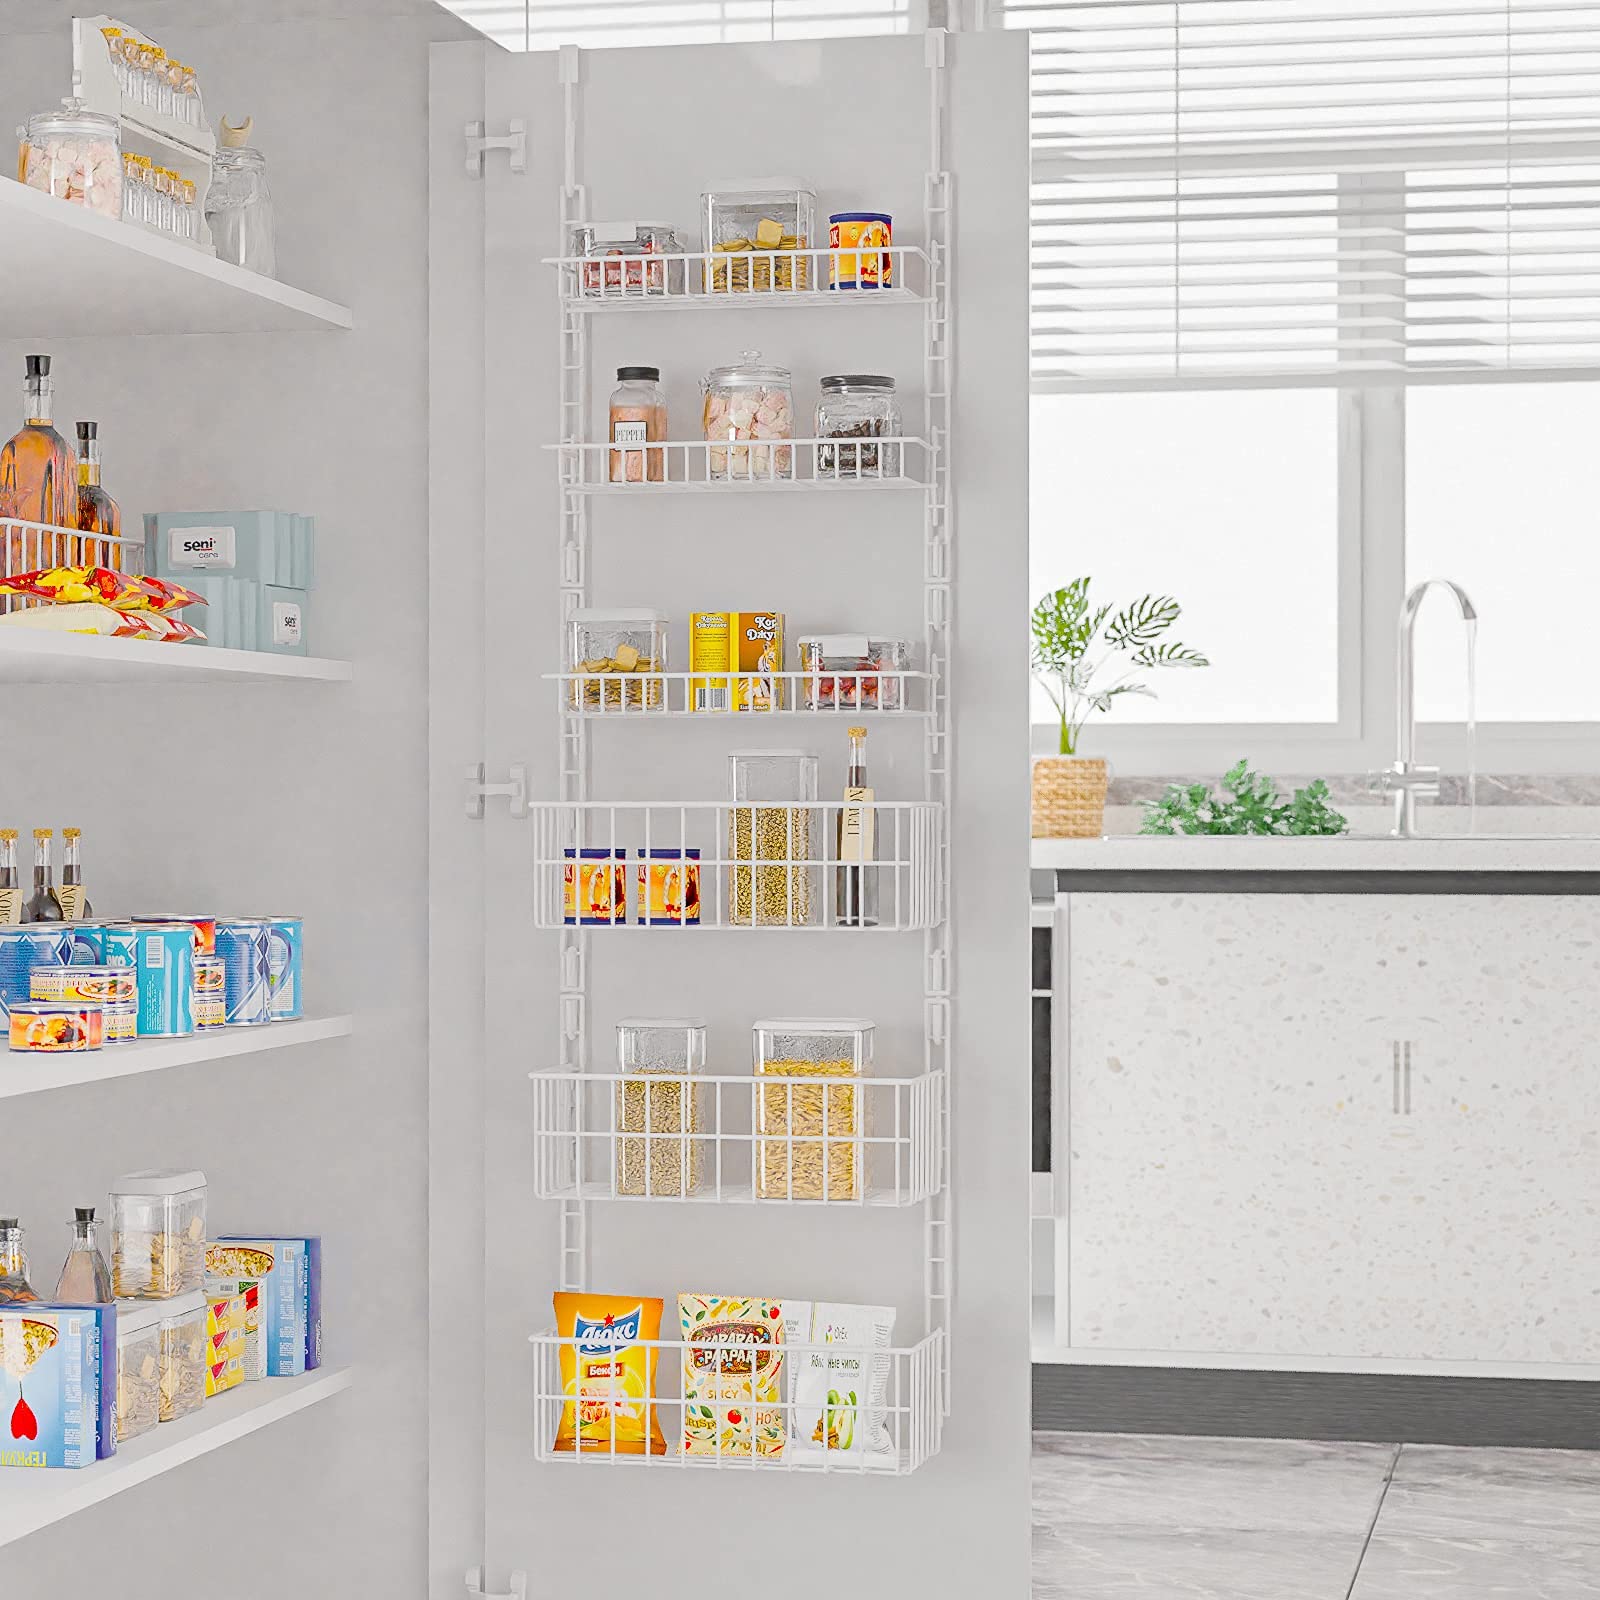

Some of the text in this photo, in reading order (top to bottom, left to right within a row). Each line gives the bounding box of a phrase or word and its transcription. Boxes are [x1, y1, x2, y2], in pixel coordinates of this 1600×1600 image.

[616, 429, 646, 441] PEPPER
[183, 537, 213, 551] seni
[707, 1389, 739, 1400] SICY
[684, 1416, 718, 1430] RISP
